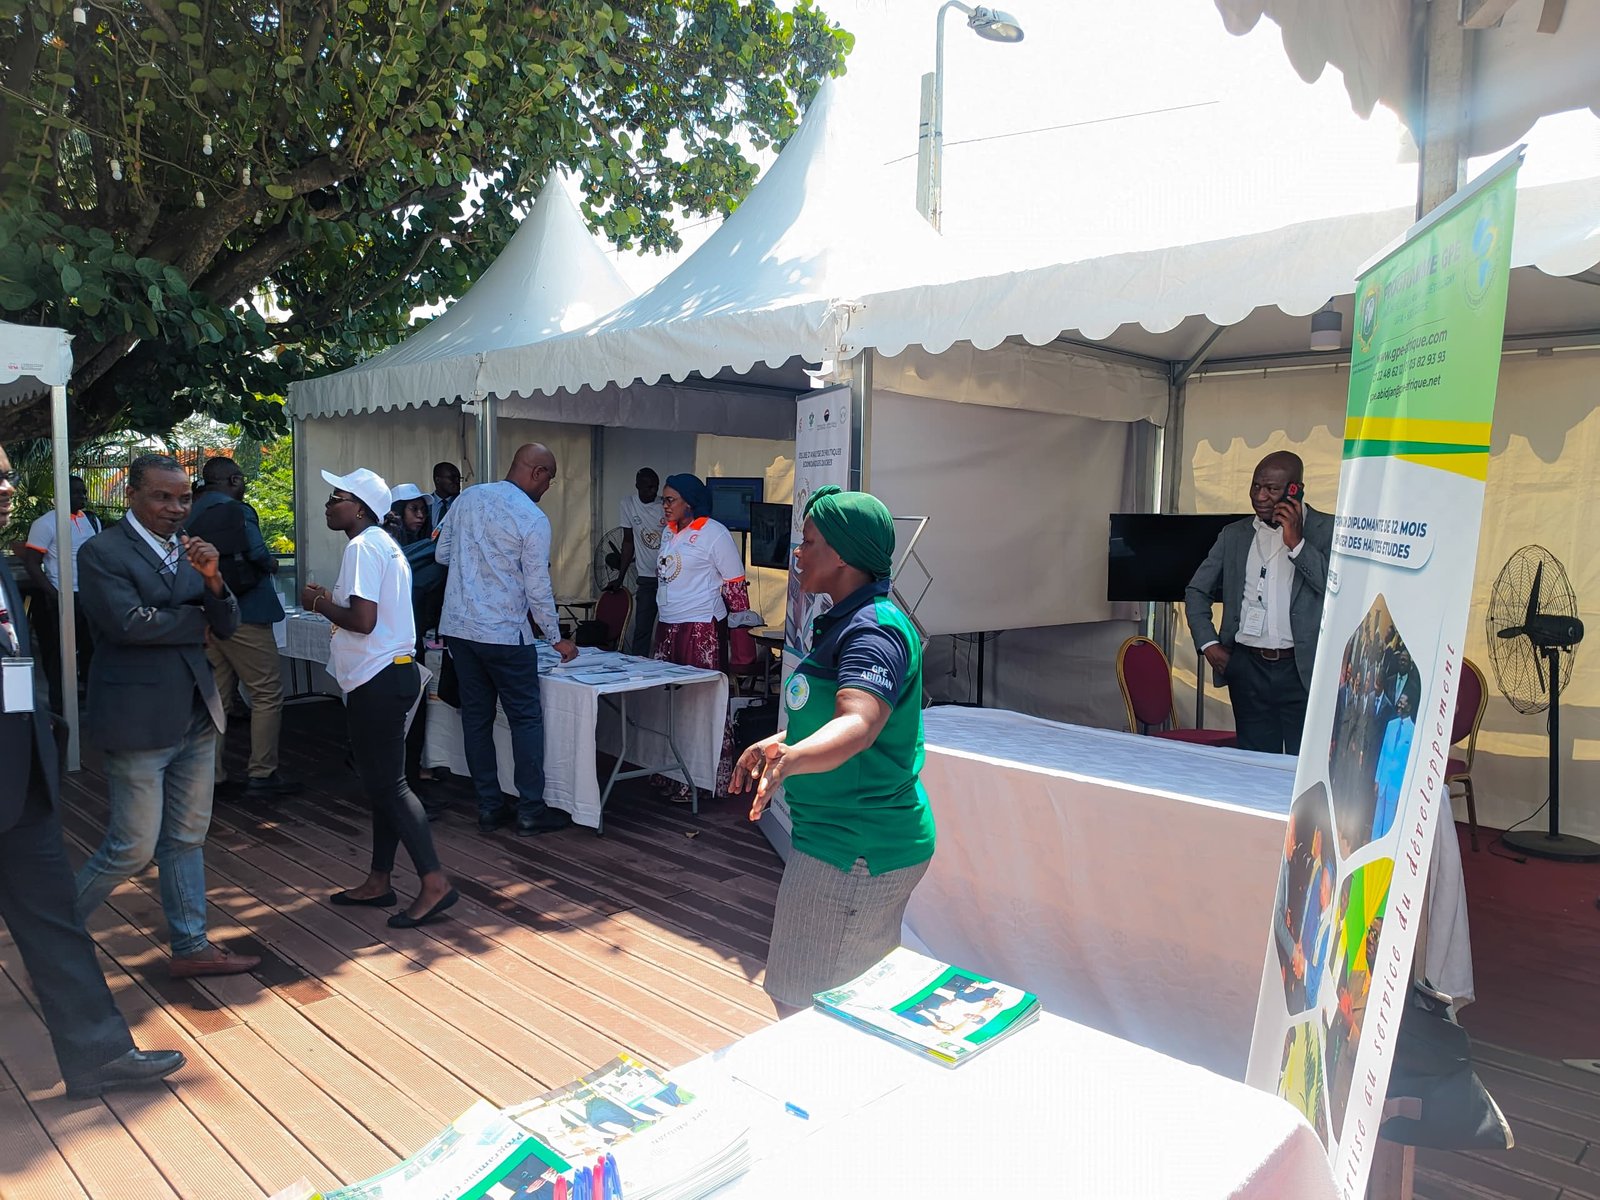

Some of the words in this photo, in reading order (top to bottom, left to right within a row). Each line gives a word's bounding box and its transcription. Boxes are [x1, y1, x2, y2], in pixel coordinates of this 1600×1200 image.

[1416, 355, 1426, 368] 82
[1426, 353, 1437, 366] 93
[1437, 350, 1446, 363] 93
[1399, 521, 1428, 538] MOIS
[1347, 536, 1362, 551] DES
[871, 664, 889, 678] GPE
[860, 671, 894, 691] ABIDJAN
[1365, 1068, 1378, 1107] au
[1374, 945, 1402, 1056] service
[1398, 892, 1412, 932] du
